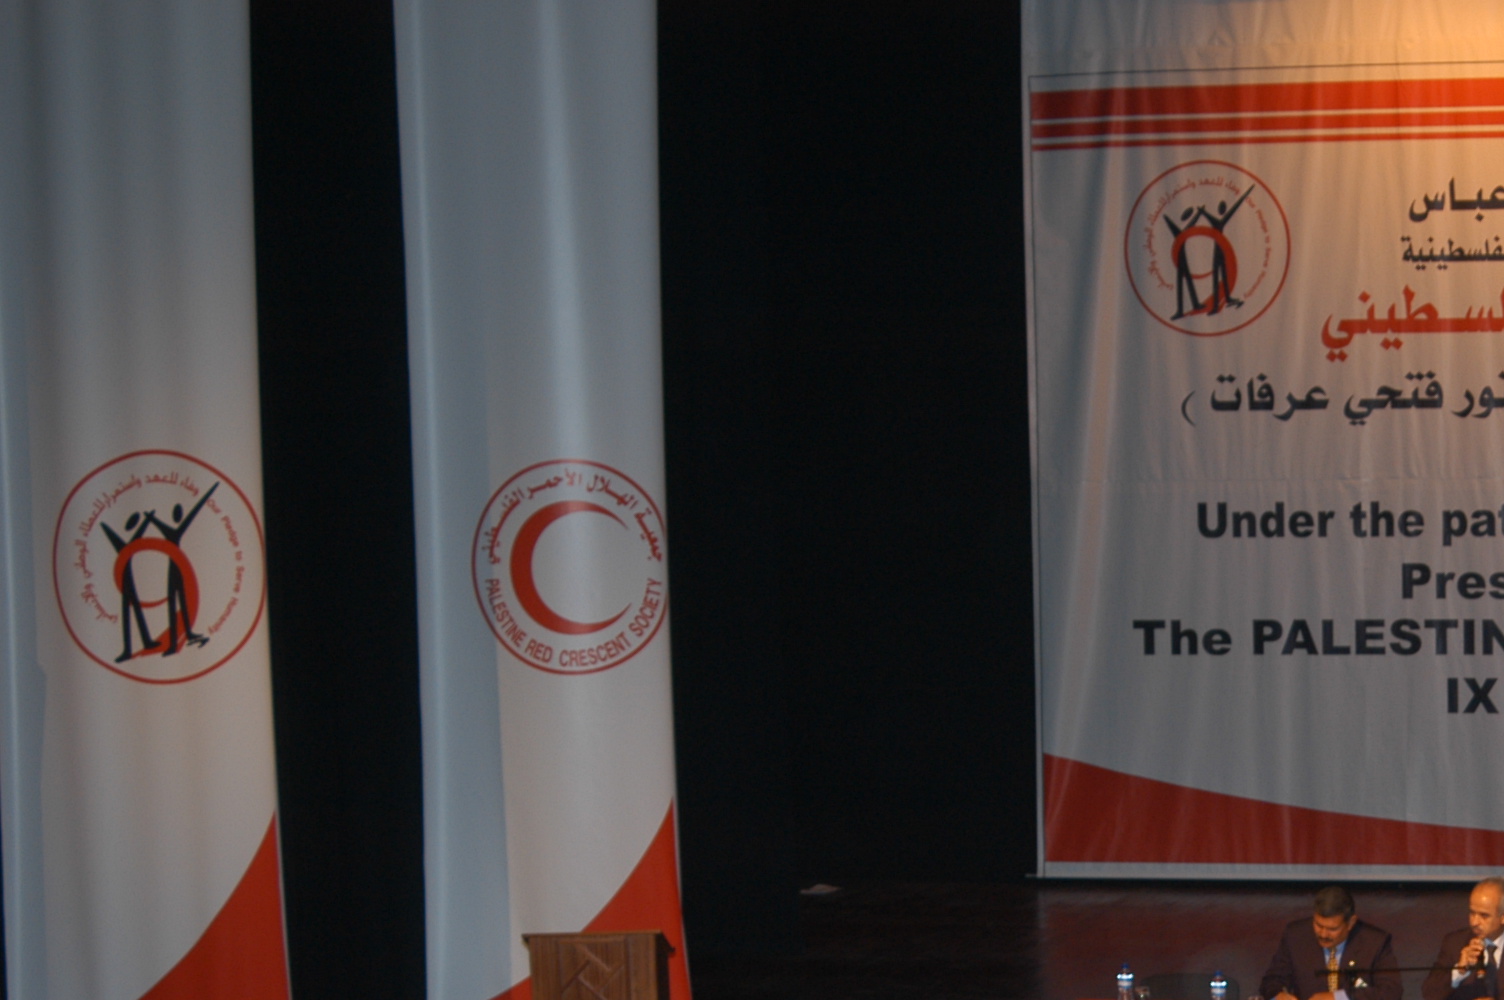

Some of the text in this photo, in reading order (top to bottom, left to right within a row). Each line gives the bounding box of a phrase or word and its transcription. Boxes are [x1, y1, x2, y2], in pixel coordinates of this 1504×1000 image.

[1210, 373, 1330, 422] عرفات
[1343, 370, 1444, 426] فتحي
[1197, 501, 1336, 539] Under
[1349, 500, 1425, 538] the
[485, 577, 662, 668] PALESTINE RED CRESCENT SOCIETY
[1132, 619, 1233, 656] The
[1447, 677, 1499, 714] IX
